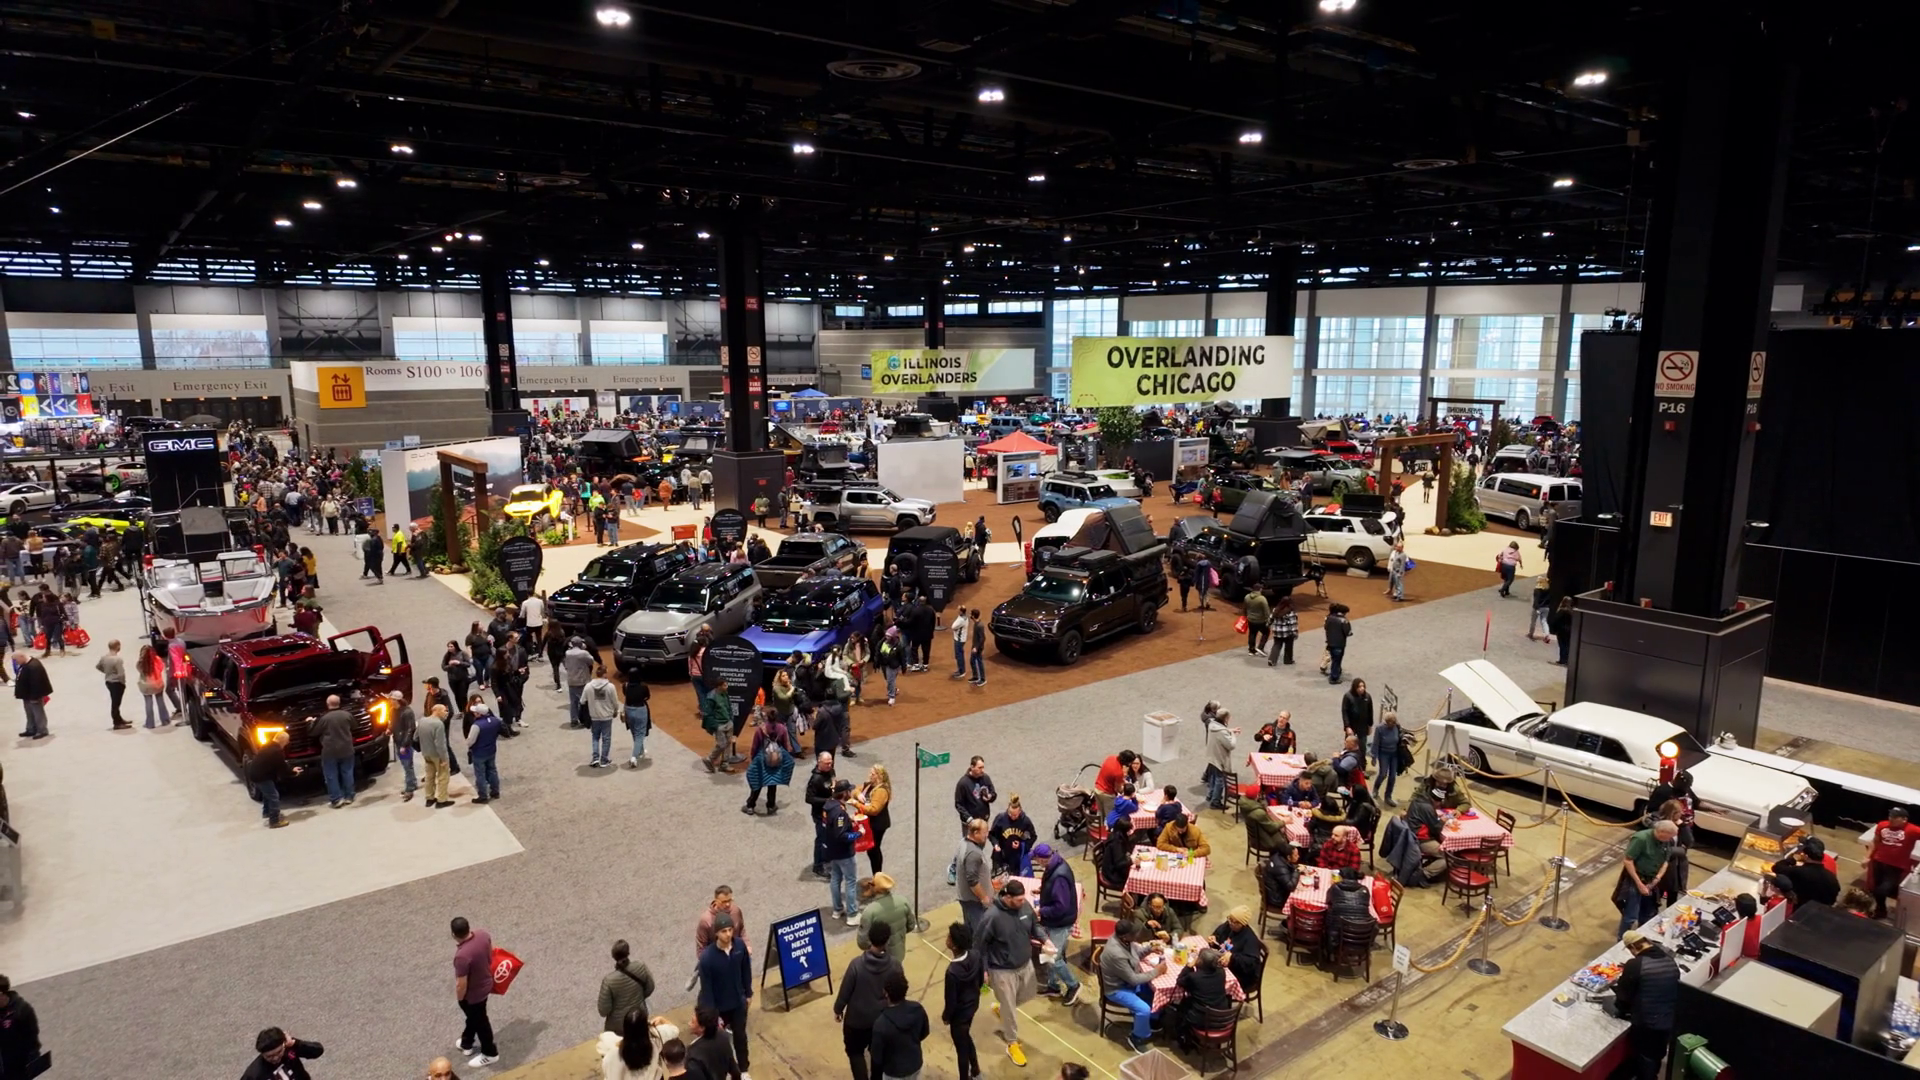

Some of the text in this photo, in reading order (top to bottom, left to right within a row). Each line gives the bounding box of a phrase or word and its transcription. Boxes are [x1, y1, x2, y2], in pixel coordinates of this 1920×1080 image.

[1106, 344, 1265, 369] OVERLANDING
[903, 357, 961, 370] ILLINOIS
[365, 366, 402, 376] Rooms
[406, 365, 442, 378] S100
[460, 365, 483, 378] 106
[519, 375, 588, 385] Emergency Exit
[613, 375, 676, 385] Emergency Exit
[767, 375, 813, 384] mergency Exit
[880, 371, 978, 386] OVERLANDERS
[1136, 371, 1236, 396] CHICAGO
[109, 382, 135, 392] Exit
[173, 380, 268, 392] Emergency Exit
[1655, 383, 1695, 391] NO SMOKING
[1658, 402, 1686, 414] P16
[1746, 403, 1758, 415] P16
[147, 437, 215, 453] GMC
[1654, 512, 1668, 522] EXIT
[778, 916, 817, 935] FOLLOW ME
[794, 927, 813, 938] YOUR
[791, 938, 810, 949] NEXT
[792, 945, 812, 958] DRIVE
